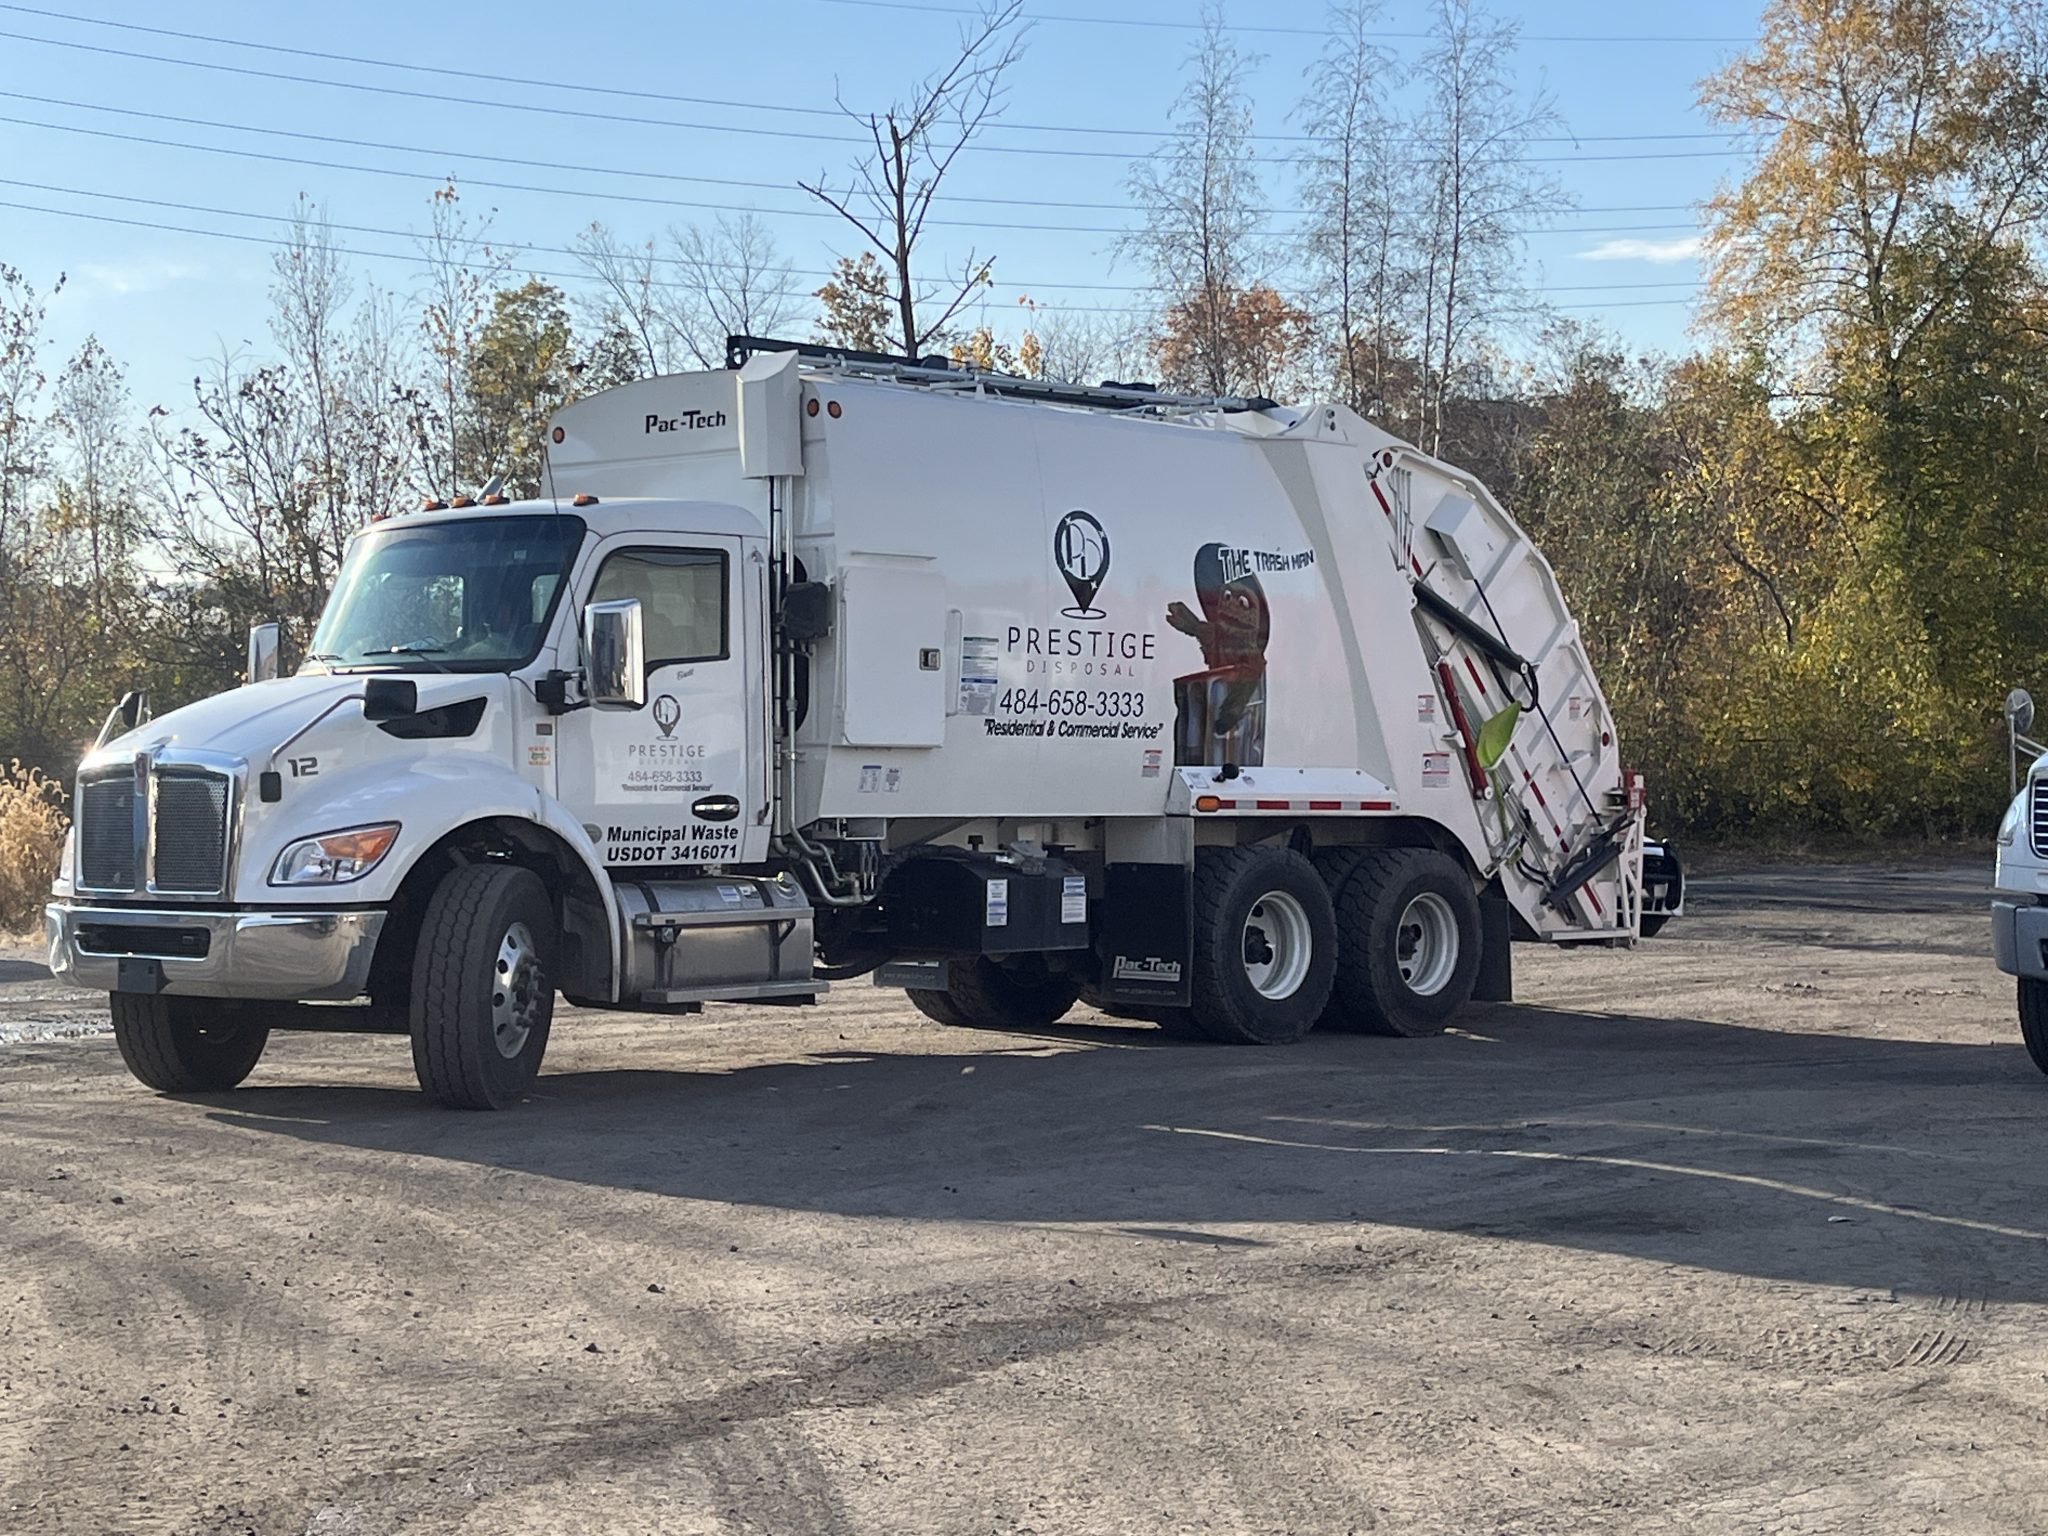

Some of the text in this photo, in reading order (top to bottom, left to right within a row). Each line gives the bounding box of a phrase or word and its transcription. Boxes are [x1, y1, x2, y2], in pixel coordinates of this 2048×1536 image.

[645, 410, 726, 434] Pac-Tech
[1219, 548, 1315, 584] THE TRASH MAN
[1007, 626, 1155, 660] PRESTIGE
[1026, 660, 1135, 677] DISPOSAL
[1000, 688, 1144, 718] 484-658-3333
[1046, 720, 1055, 737] &
[1058, 720, 1120, 738] Commercial
[628, 745, 705, 757] PRESTIGE
[288, 757, 319, 777] 12
[628, 770, 703, 782] 484-658-3333
[607, 825, 738, 844] Municipal Waste
[607, 845, 737, 861] USDOT 3416071
[1112, 955, 1181, 979] Pac-Tech
